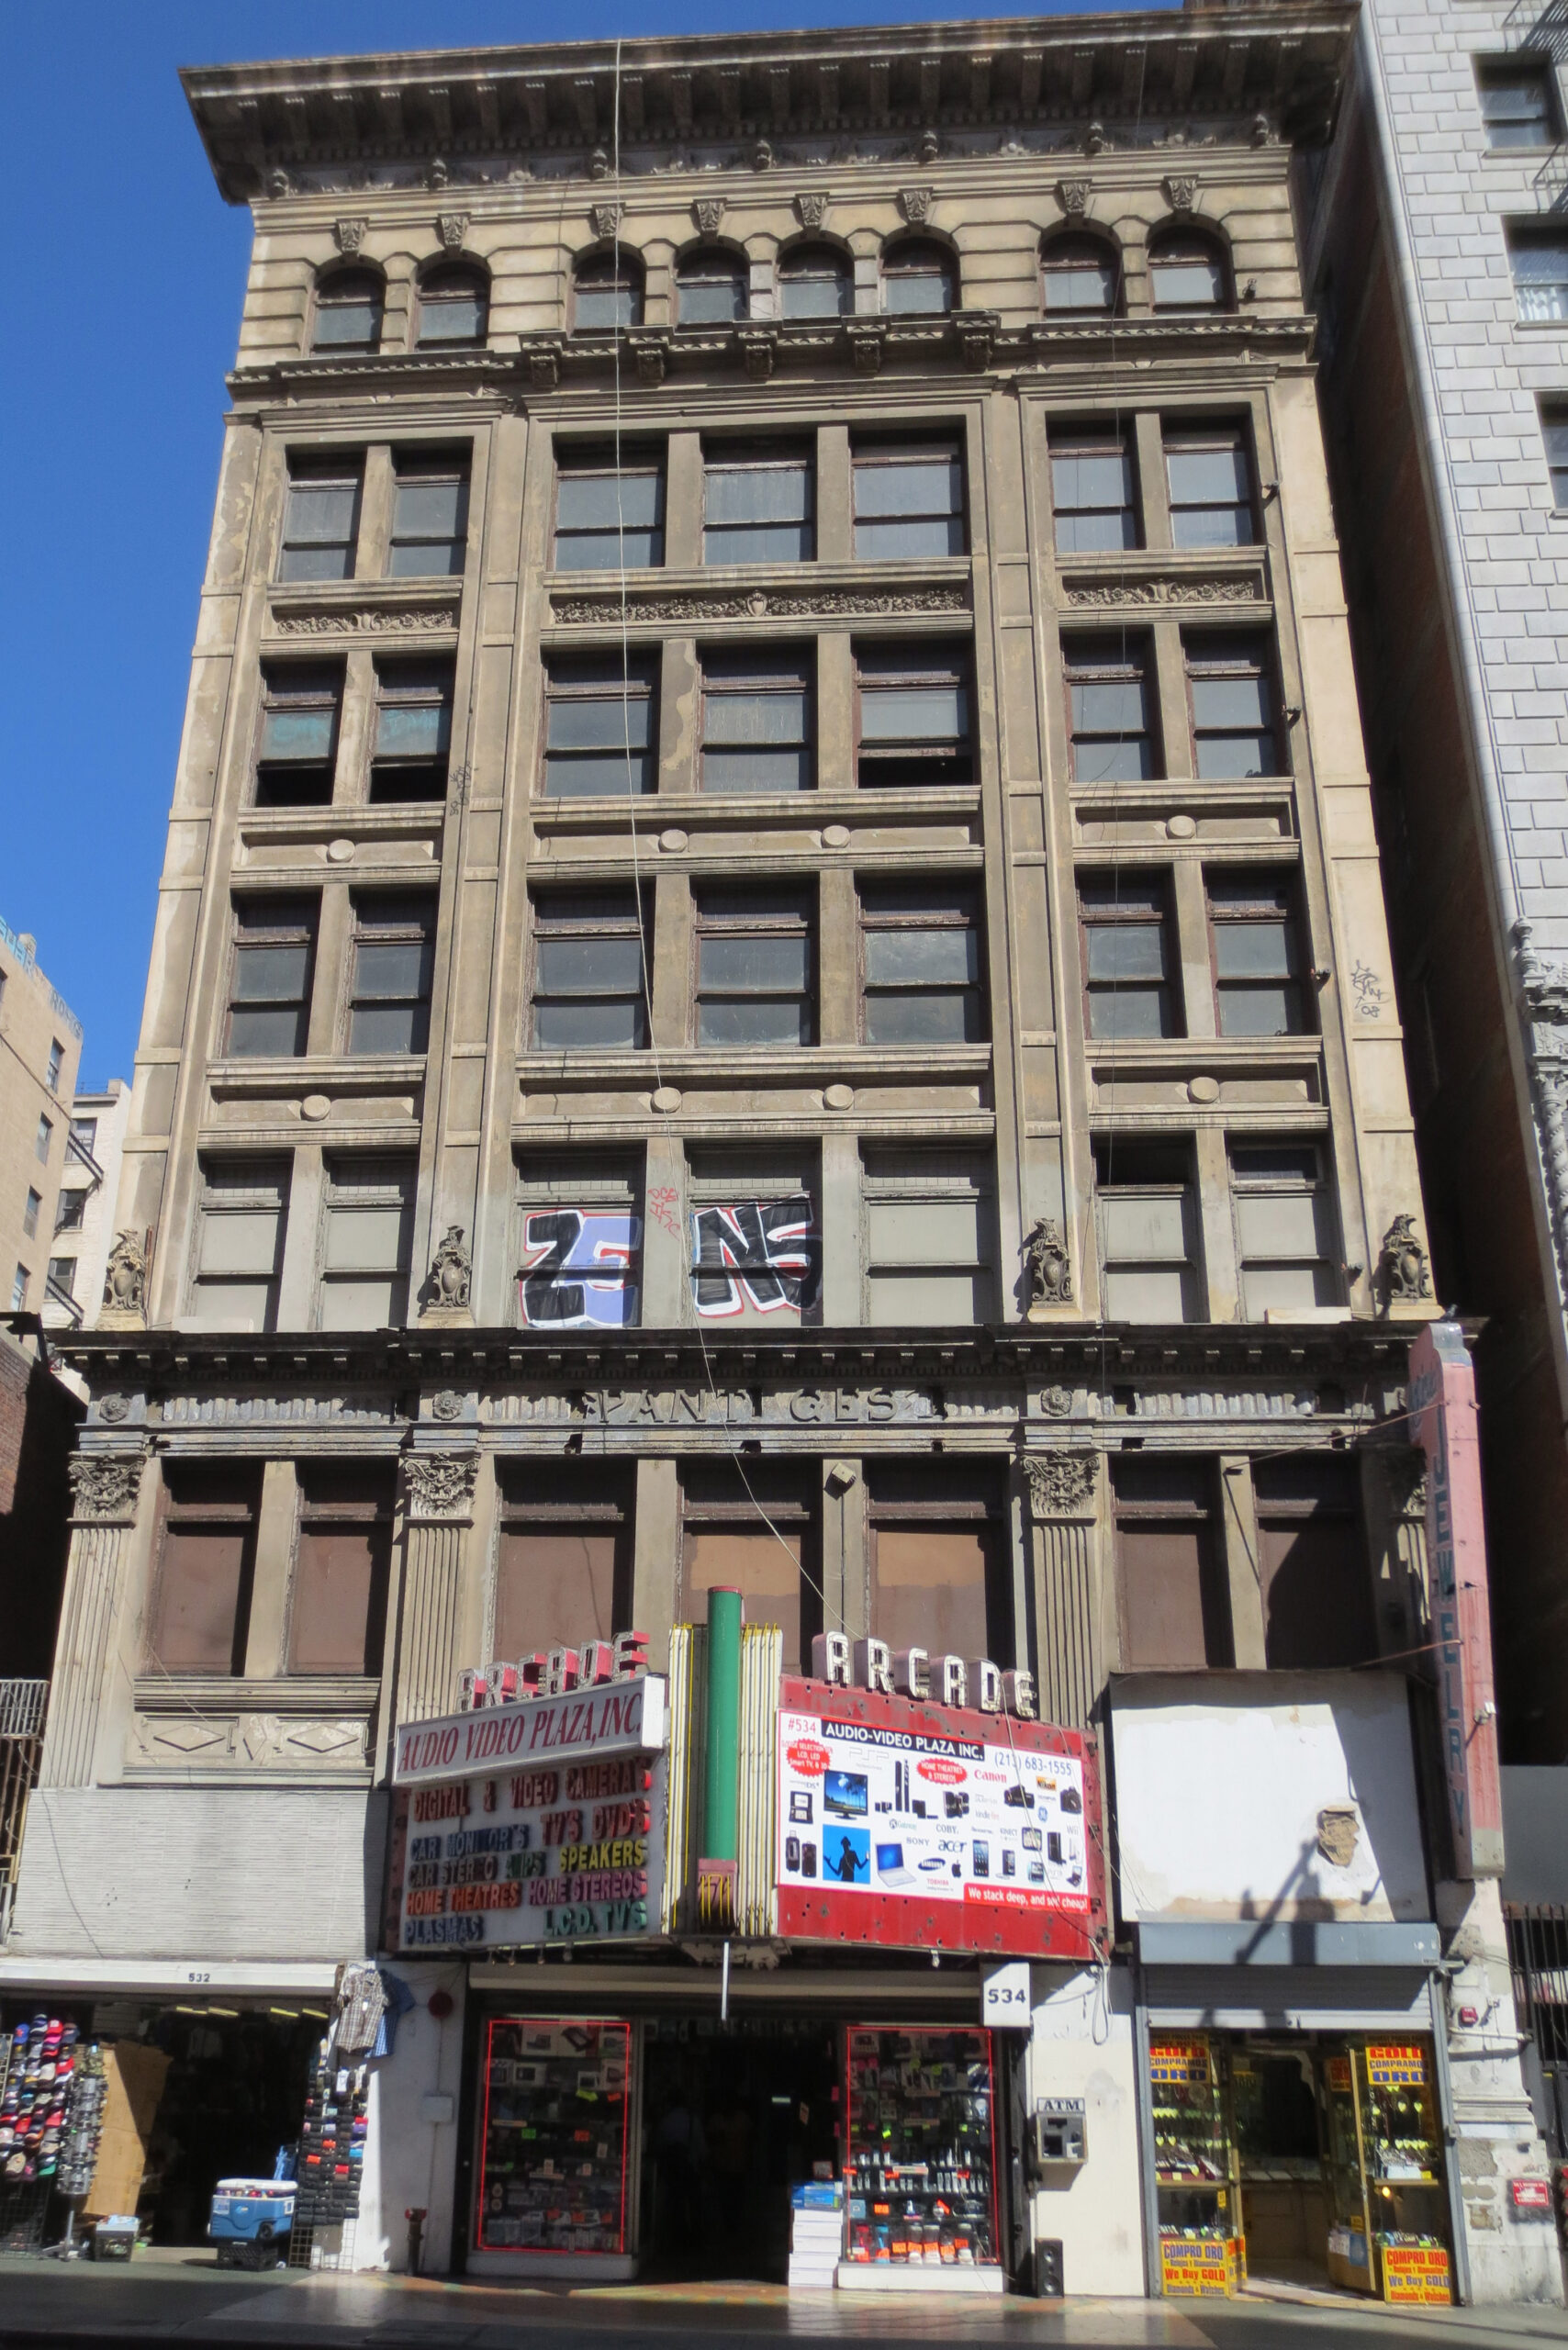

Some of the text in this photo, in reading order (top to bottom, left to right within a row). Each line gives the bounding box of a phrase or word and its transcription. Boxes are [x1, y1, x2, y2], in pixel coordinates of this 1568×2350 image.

[1433, 1405, 1464, 1832] JEWELRY
[814, 1630, 1036, 1719] ARCADE
[398, 1726, 459, 1773] AUDIO
[465, 1714, 525, 1763] VIDEO
[788, 1718, 983, 1760] #534 AUDIO-VIDEO PLAZA INC.
[1025, 1756, 1071, 1776] 683-1555
[974, 1769, 1007, 1783] Canon
[414, 1785, 470, 1822] DIGITAL
[483, 1780, 496, 1812] &
[510, 1771, 558, 1808] VIDEO
[540, 1798, 651, 1845] TV'S DVD'S
[410, 1824, 530, 1862] CAR MONIOR'S
[906, 1837, 929, 1846] SONY
[938, 1839, 967, 1853] acer
[409, 1863, 439, 1888] CAR
[442, 1855, 498, 1886] STERO
[559, 1839, 647, 1873] SPEAKERS
[927, 1878, 949, 1886] TOSHIBA
[407, 1888, 446, 1916] HOME
[448, 1879, 522, 1912] THEATRES
[529, 1876, 571, 1906] HOME
[968, 1887, 981, 1900] We
[983, 1890, 1005, 1902] stack
[1006, 1891, 1028, 1907] deep,
[1030, 1894, 1046, 1906] and
[404, 1915, 484, 1944] PLASMAS
[188, 1973, 210, 1982] 532
[988, 1988, 1026, 2004] 534
[1149, 2047, 1205, 2057] GOLD
[1370, 2047, 1424, 2059] GOLD
[1151, 2069, 1206, 2081] ORO
[1372, 2071, 1428, 2082] ORO
[1044, 2099, 1080, 2111] ATM
[1164, 2245, 1223, 2260] COMPRO ORO
[1386, 2251, 1447, 2266] COMPRO ORO
[1165, 2267, 1226, 2281] We Buy GOLD
[1388, 2275, 1450, 2288] We Buy GOLD
